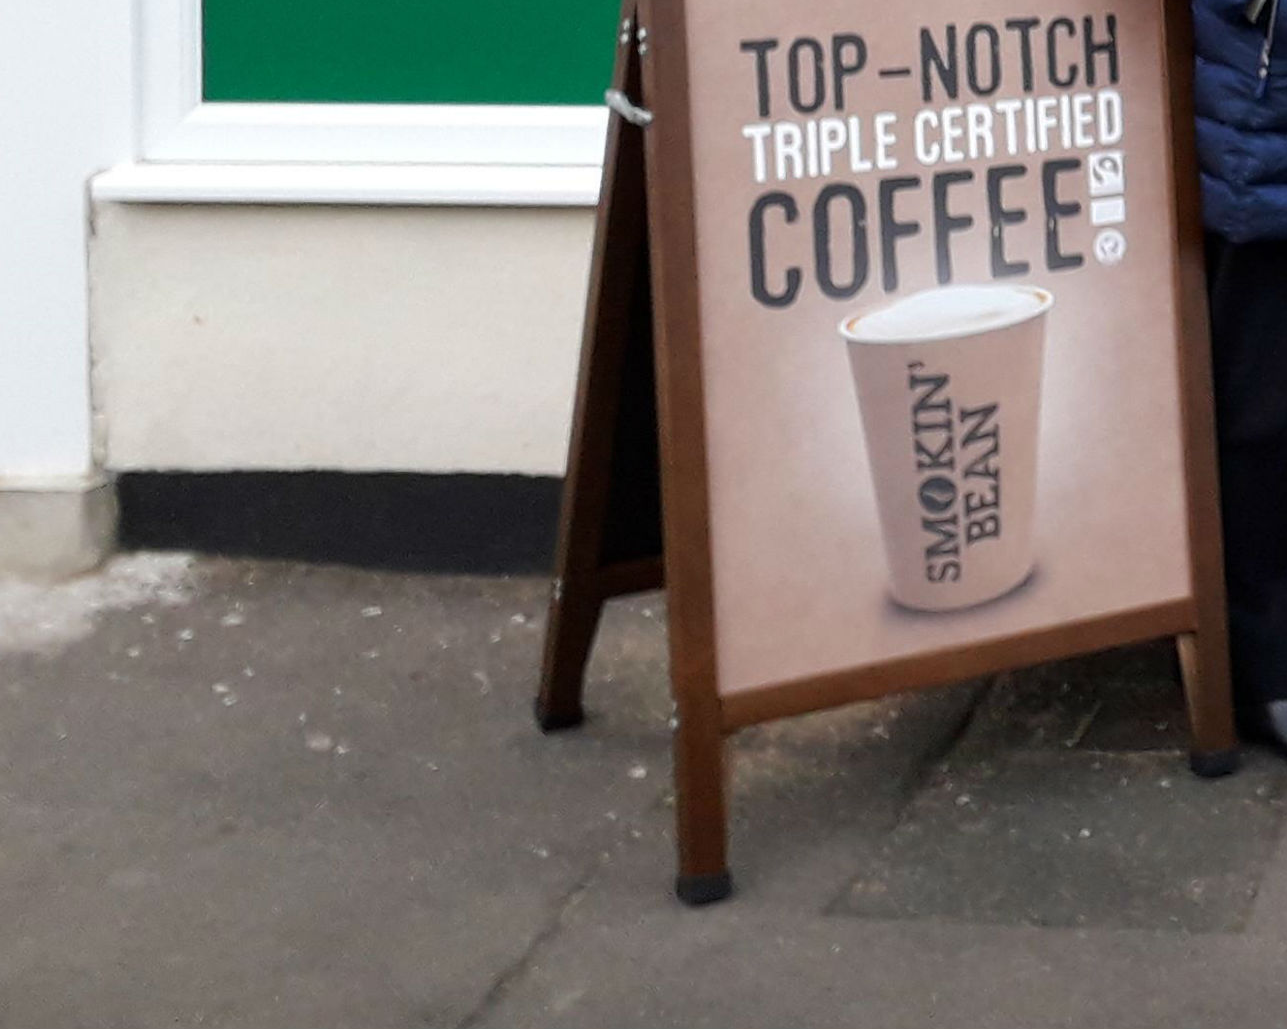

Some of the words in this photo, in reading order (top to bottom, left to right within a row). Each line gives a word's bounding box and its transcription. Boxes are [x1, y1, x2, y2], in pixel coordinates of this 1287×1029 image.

[742, 113, 898, 182] TRIPLE
[914, 89, 1123, 165] CERTIFIED
[748, 158, 1083, 307] COFFEE
[907, 360, 961, 583] SMOKIN'
[960, 402, 1000, 546] BEAN
